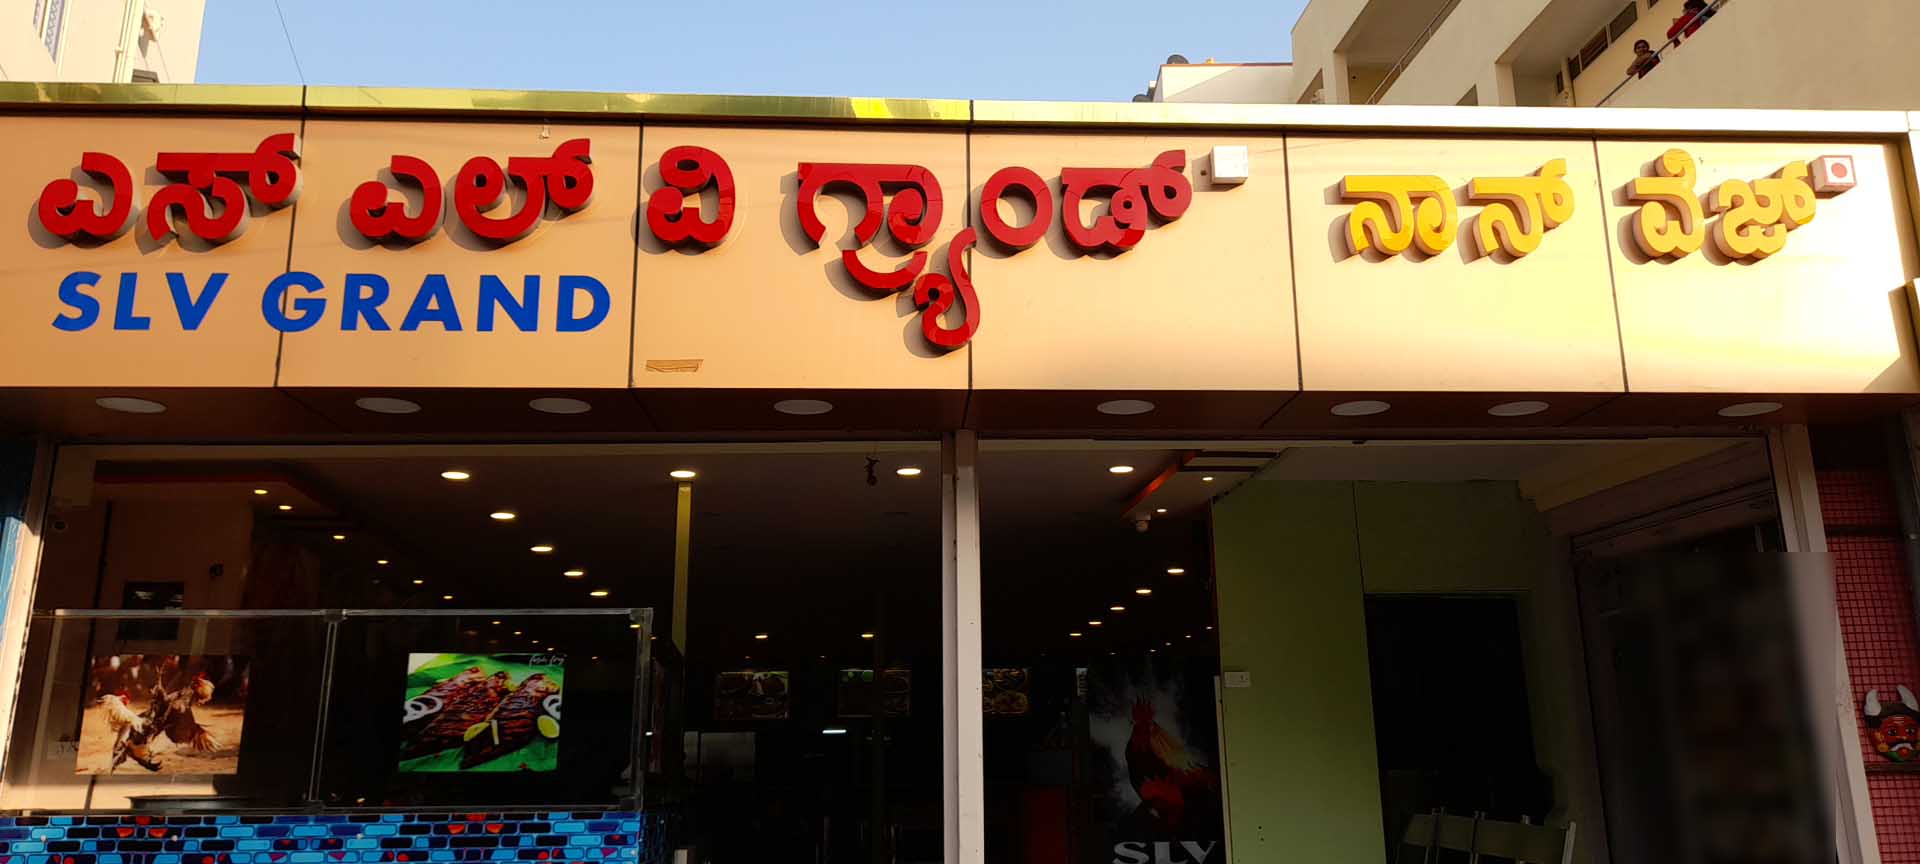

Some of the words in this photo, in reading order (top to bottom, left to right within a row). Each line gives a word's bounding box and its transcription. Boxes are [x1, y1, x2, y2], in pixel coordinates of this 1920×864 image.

[38, 134, 299, 242] ಎಸ್
[350, 138, 595, 242] ಎಲ್
[646, 146, 736, 246] ವಿ
[1341, 158, 1575, 257] ನಾನ್
[1629, 149, 1817, 258] ವೆಜ್
[53, 272, 228, 331] SLV
[262, 272, 611, 332] GRAND
[1112, 841, 1217, 864] SLV
